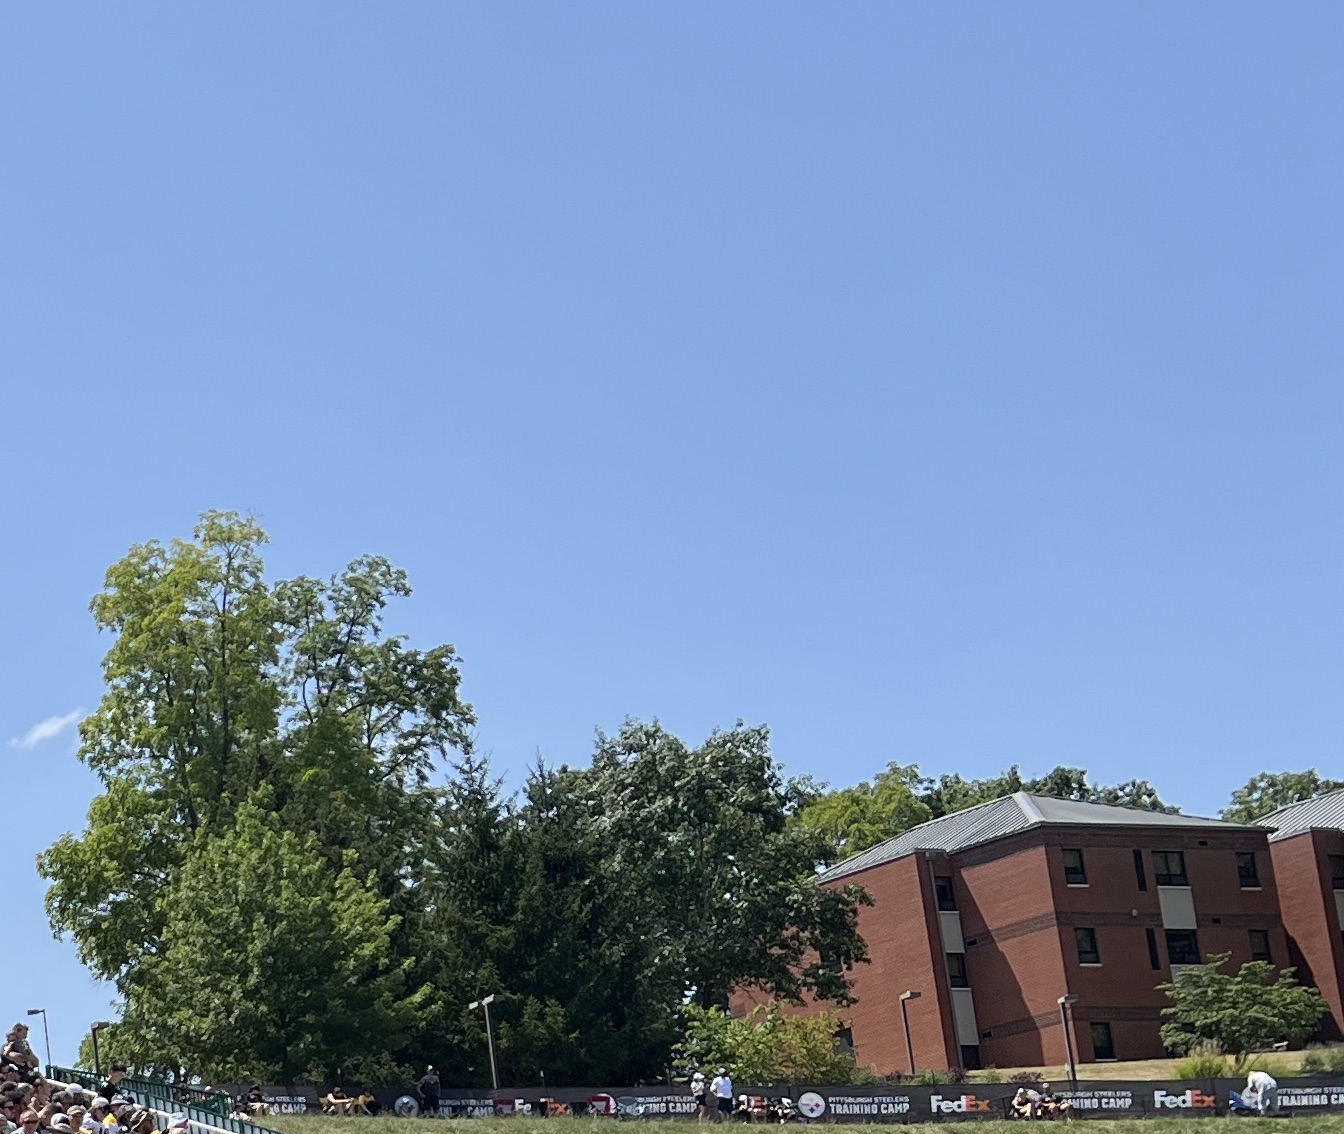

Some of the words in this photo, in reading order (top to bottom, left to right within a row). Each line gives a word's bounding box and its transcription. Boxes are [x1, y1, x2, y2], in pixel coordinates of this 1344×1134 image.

[930, 1094, 991, 1113] FedEx
[1102, 1098, 1132, 1108] CAMP
[1154, 1089, 1217, 1108] FedEx
[669, 1102, 697, 1113] CAMP
[830, 1103, 877, 1114] TRAINING
[880, 1103, 910, 1114] CAMP
